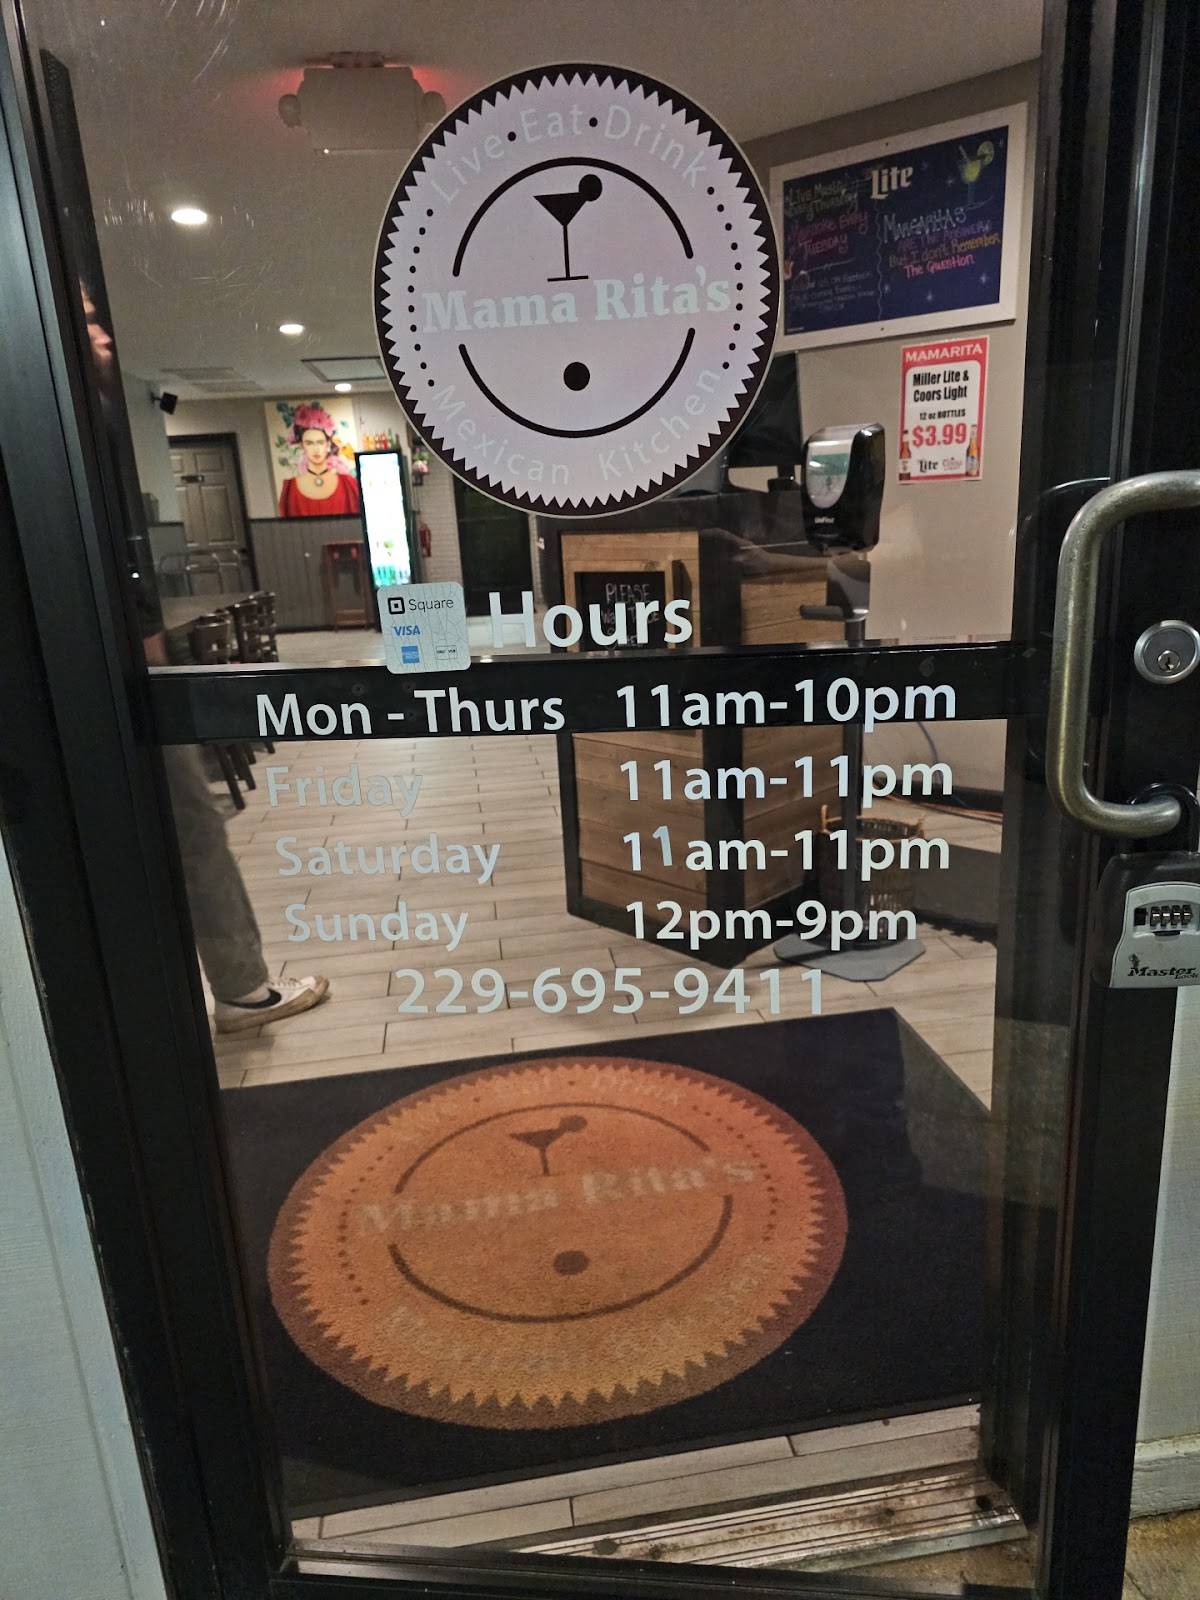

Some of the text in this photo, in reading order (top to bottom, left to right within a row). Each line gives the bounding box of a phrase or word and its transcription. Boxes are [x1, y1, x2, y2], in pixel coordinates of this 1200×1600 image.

[431, 103, 708, 203] Live Eat Drink
[870, 165, 914, 200] Lite
[421, 288, 579, 334] Mama
[593, 265, 733, 322] Rita's
[905, 343, 984, 363] MAMARITA
[913, 369, 969, 387] Miller Lite &
[913, 386, 968, 403] Coors Light
[433, 368, 722, 486] Mexican Kitchen
[919, 412, 927, 420] 12
[937, 409, 966, 420] BOTTLES
[912, 422, 968, 448] $3.99
[919, 459, 939, 473] Lite
[408, 599, 454, 613] Square
[488, 590, 693, 649] Hours
[394, 625, 421, 637] VISA
[256, 693, 372, 737] Mon
[414, 687, 566, 733] Thurs
[616, 677, 956, 733] 11am-10pm
[265, 755, 954, 817] Friday 11am-11pm
[275, 832, 501, 885] Saturday
[285, 900, 917, 952] Sunday 12pm-9pm
[1128, 966, 1196, 977] Master
[395, 967, 823, 1015] 229-695-9411
